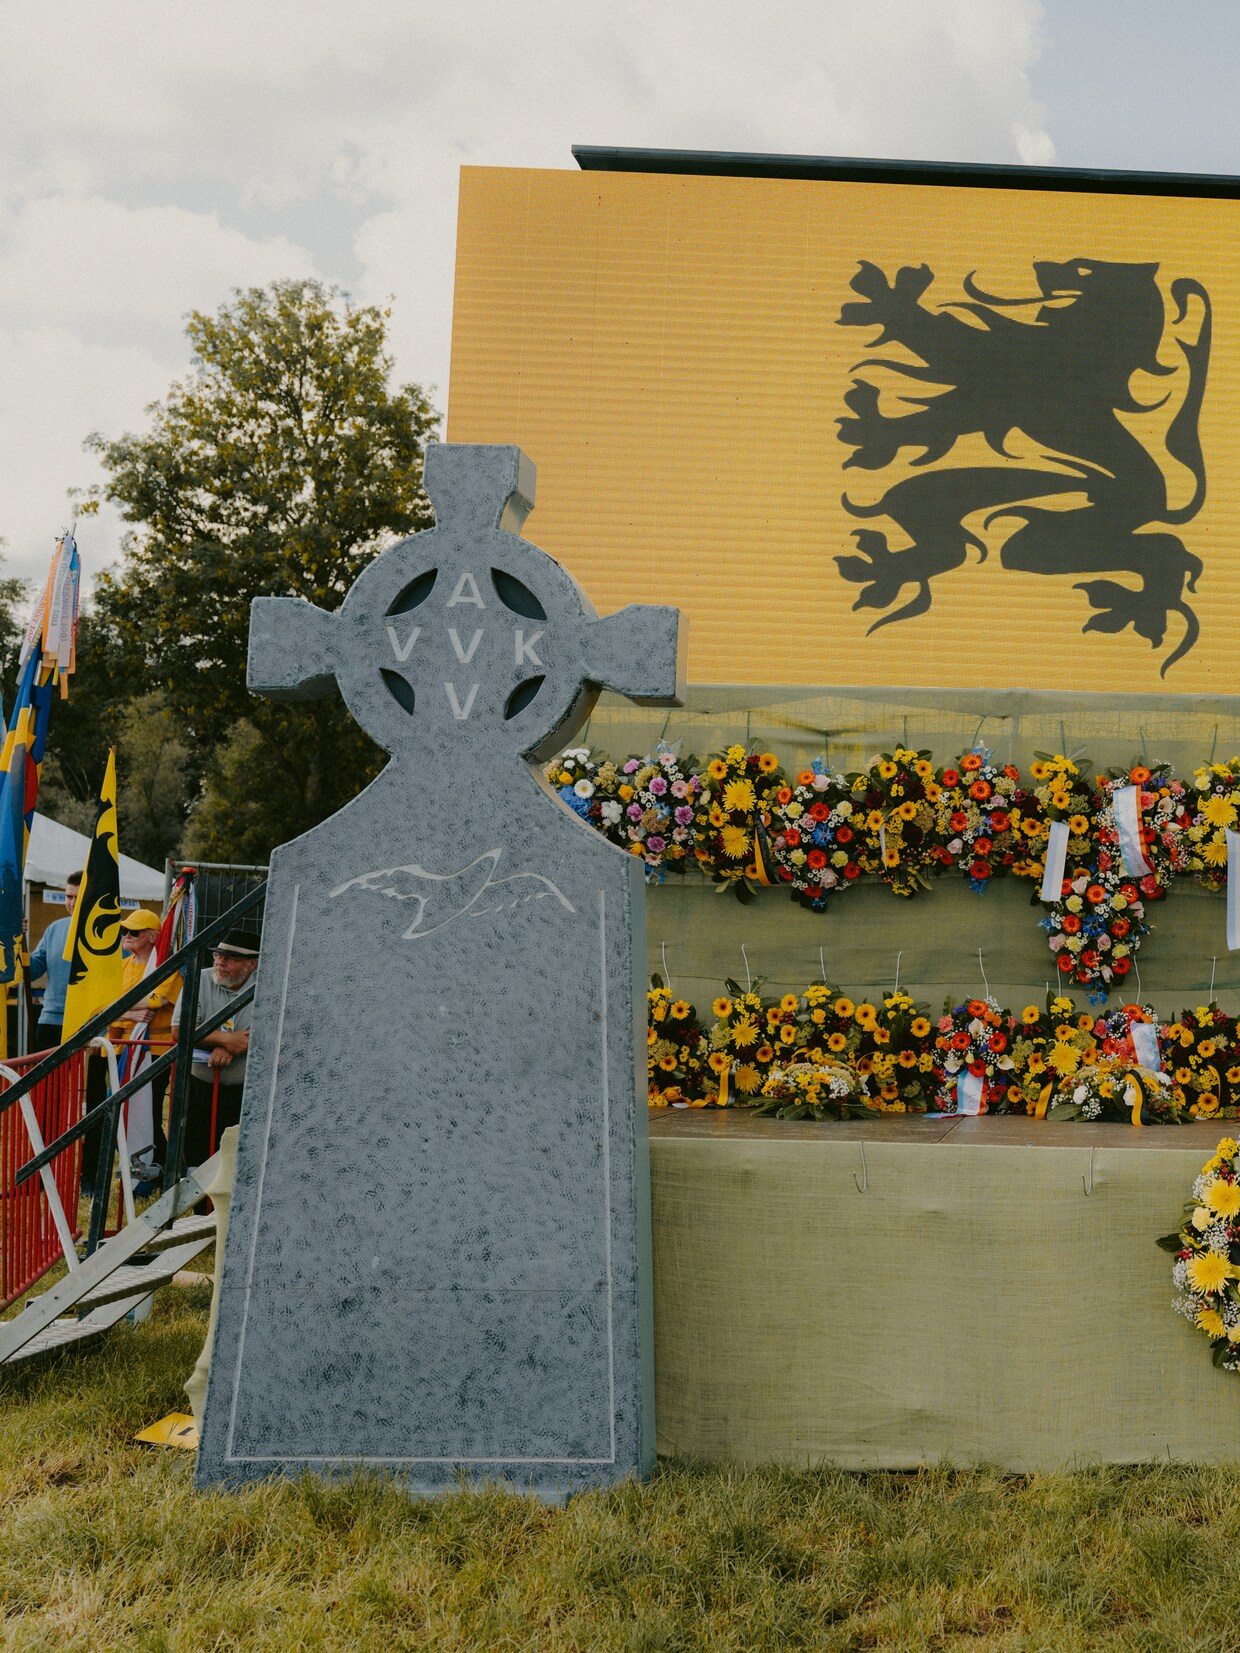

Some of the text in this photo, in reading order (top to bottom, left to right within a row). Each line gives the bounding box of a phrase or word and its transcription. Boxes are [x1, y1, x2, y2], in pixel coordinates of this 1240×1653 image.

[446, 572, 486, 610] A
[386, 625, 546, 666] V V K
[443, 681, 479, 720] V
